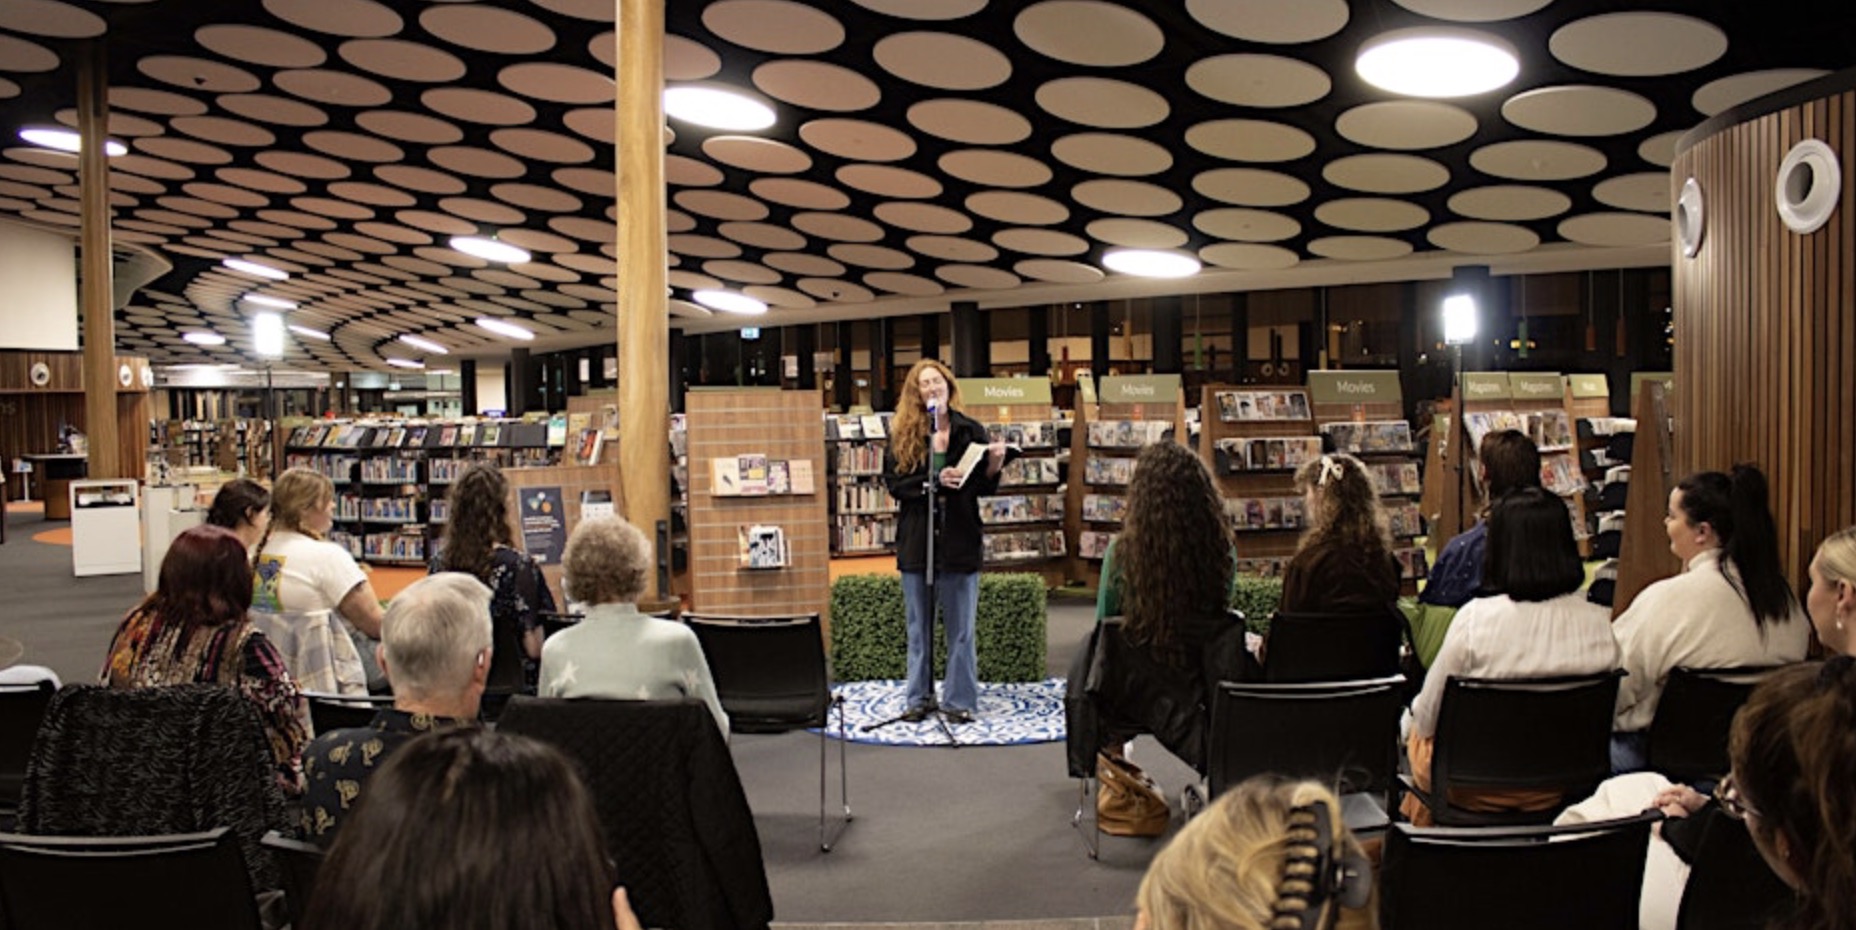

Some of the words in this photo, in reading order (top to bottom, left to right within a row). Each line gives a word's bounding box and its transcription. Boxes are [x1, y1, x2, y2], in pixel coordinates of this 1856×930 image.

[984, 385, 1024, 398] Movies
[1122, 383, 1155, 397] Movies
[1336, 380, 1376, 394] Movies
